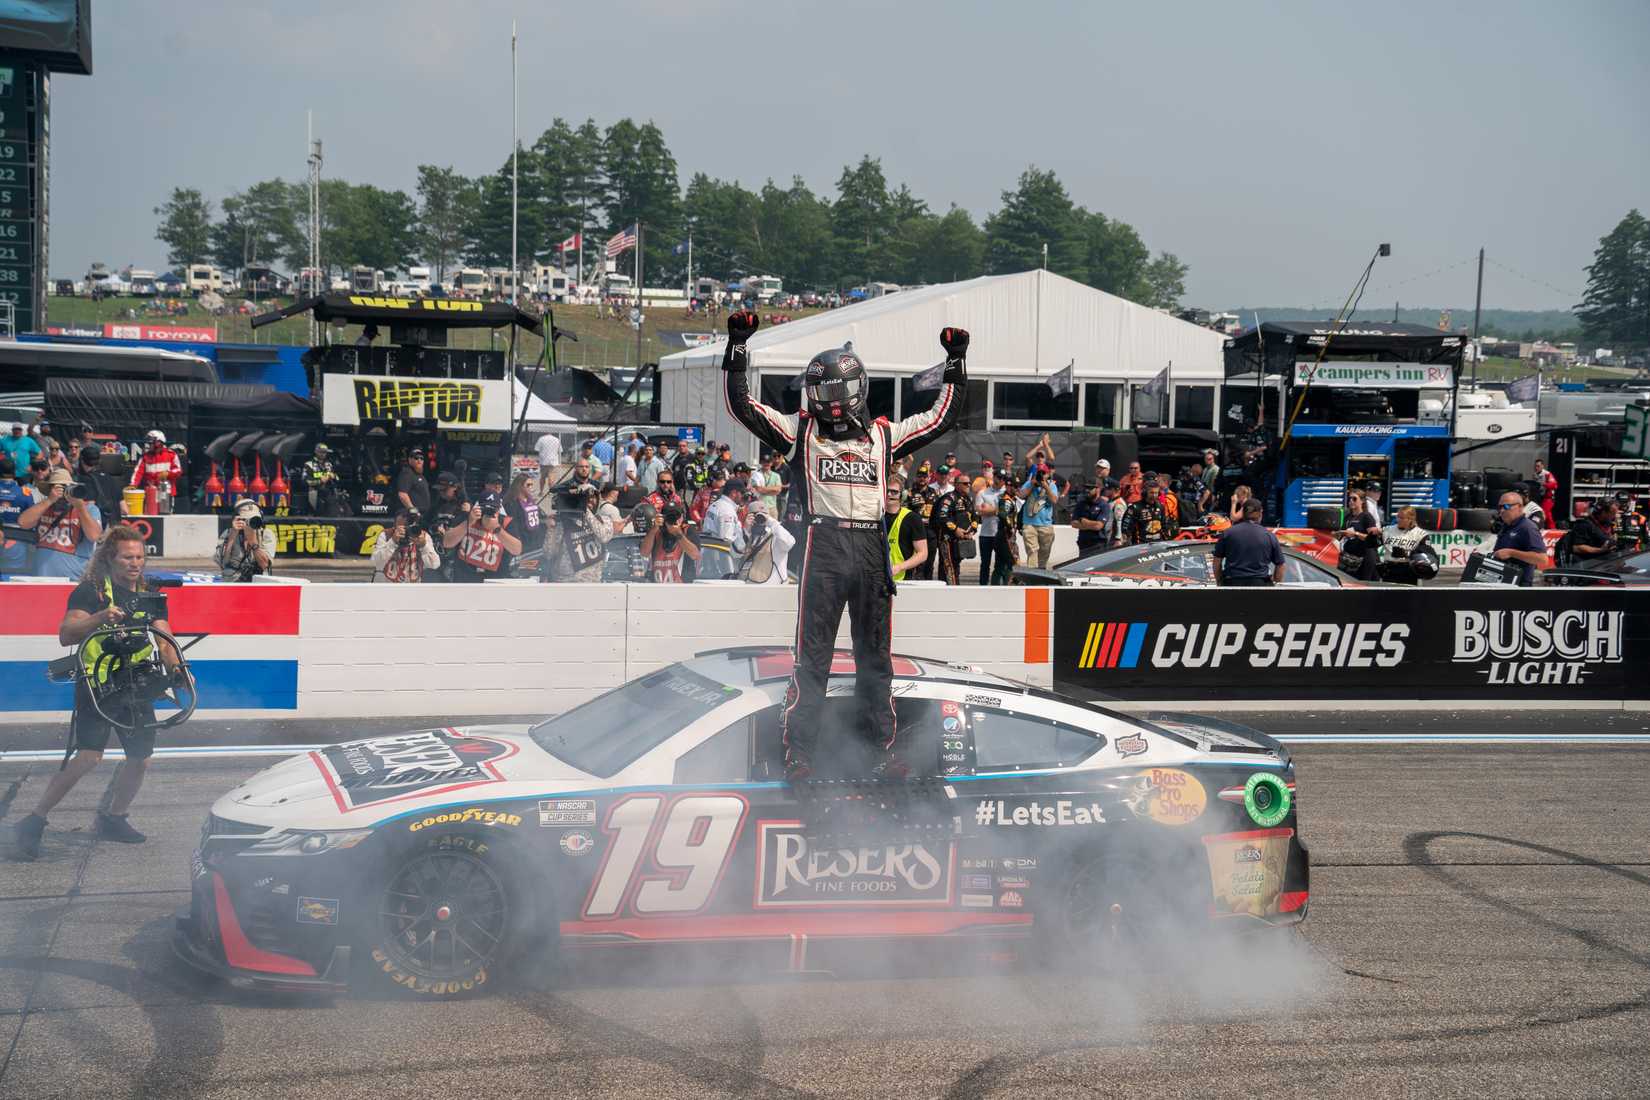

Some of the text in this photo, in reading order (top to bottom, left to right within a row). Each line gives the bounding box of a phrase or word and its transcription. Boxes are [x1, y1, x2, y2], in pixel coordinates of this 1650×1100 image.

[147, 330, 212, 341] TOYOTA
[1317, 364, 1449, 383] campers inn RV
[353, 379, 484, 424] RAPTOR
[1151, 623, 1411, 668] CUP SERIES
[1451, 609, 1625, 663] BUSCH
[1151, 769, 1186, 786] Bass
[556, 802, 588, 810] NASCAR
[975, 800, 1106, 826] #LetsEat
[1160, 799, 1200, 821] Shops
[408, 807, 523, 832] GOODYEAR
[428, 835, 489, 855] EAGLE
[581, 791, 750, 922] 19
[815, 880, 897, 892] FINE FOODS
